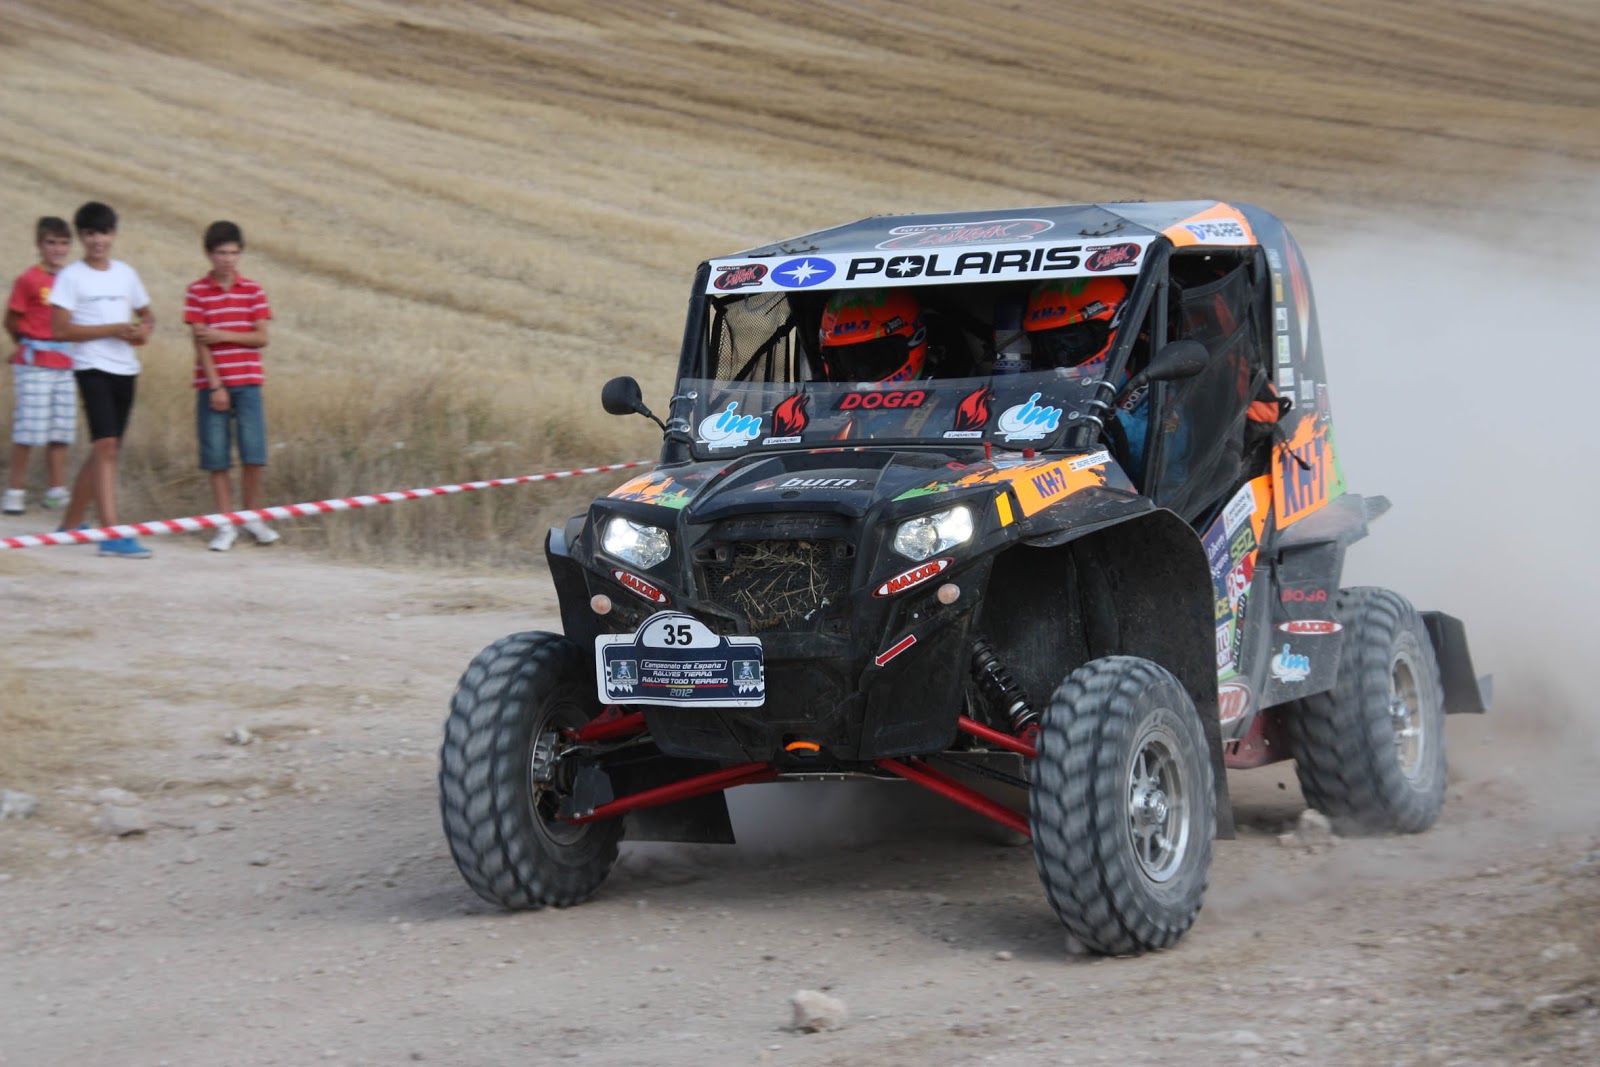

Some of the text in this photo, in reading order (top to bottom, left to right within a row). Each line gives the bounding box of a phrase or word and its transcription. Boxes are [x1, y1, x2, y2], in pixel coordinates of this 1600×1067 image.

[846, 246, 1082, 281] POLARIS
[1031, 306, 1067, 321] KH-7
[833, 320, 870, 336] KH-7
[840, 390, 926, 410] DOGA
[780, 478, 858, 487] burn
[1031, 467, 1067, 499] KH-7
[887, 560, 941, 594] MAXXIS
[620, 572, 662, 602] MAXXIS
[663, 624, 693, 646] 35
[644, 661, 681, 670] Campeonato
[693, 662, 722, 670] España
[641, 676, 669, 684] RALLYES
[690, 677, 728, 685] TERRENO
[669, 688, 693, 697] 2012
